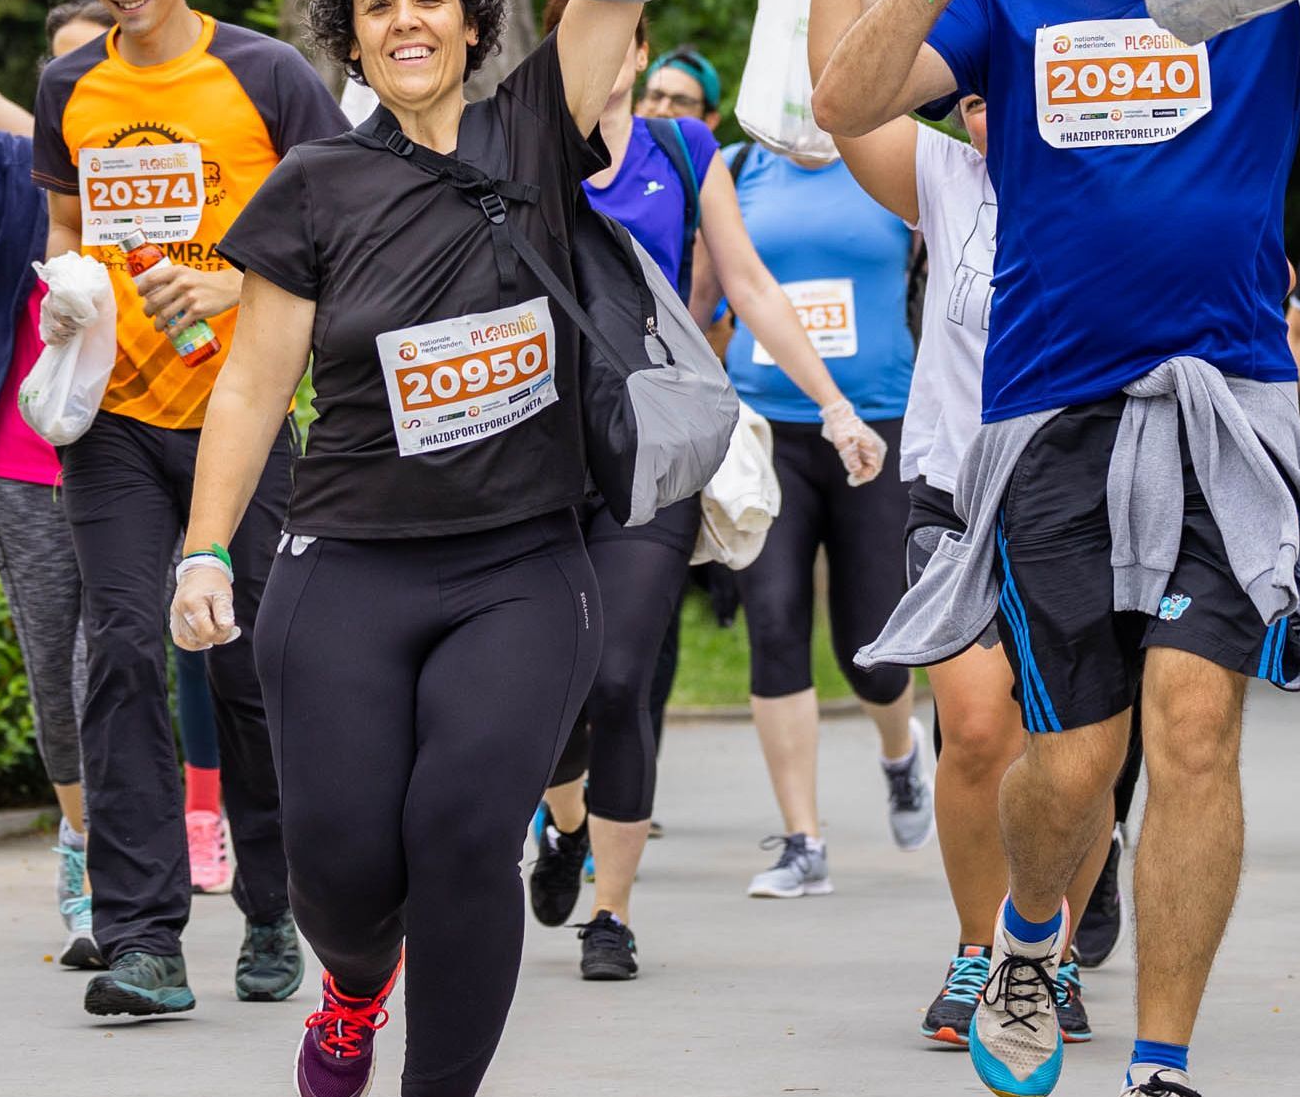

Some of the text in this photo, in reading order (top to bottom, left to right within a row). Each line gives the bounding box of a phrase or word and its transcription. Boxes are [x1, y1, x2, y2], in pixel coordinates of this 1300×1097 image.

[1074, 35, 1105, 43] nationale
[1074, 41, 1116, 50] nederlanden
[1051, 60, 1194, 99] 20940
[1060, 126, 1177, 143] #HAZDEPORTEPORELPLAN
[91, 177, 193, 207] 20374
[419, 335, 451, 347] nationale
[469, 316, 537, 346] PLOGGING
[421, 340, 463, 354] nederlanden
[402, 343, 543, 405] 20950
[420, 396, 542, 446] #HAZDEPORTEPORELPLANETA
